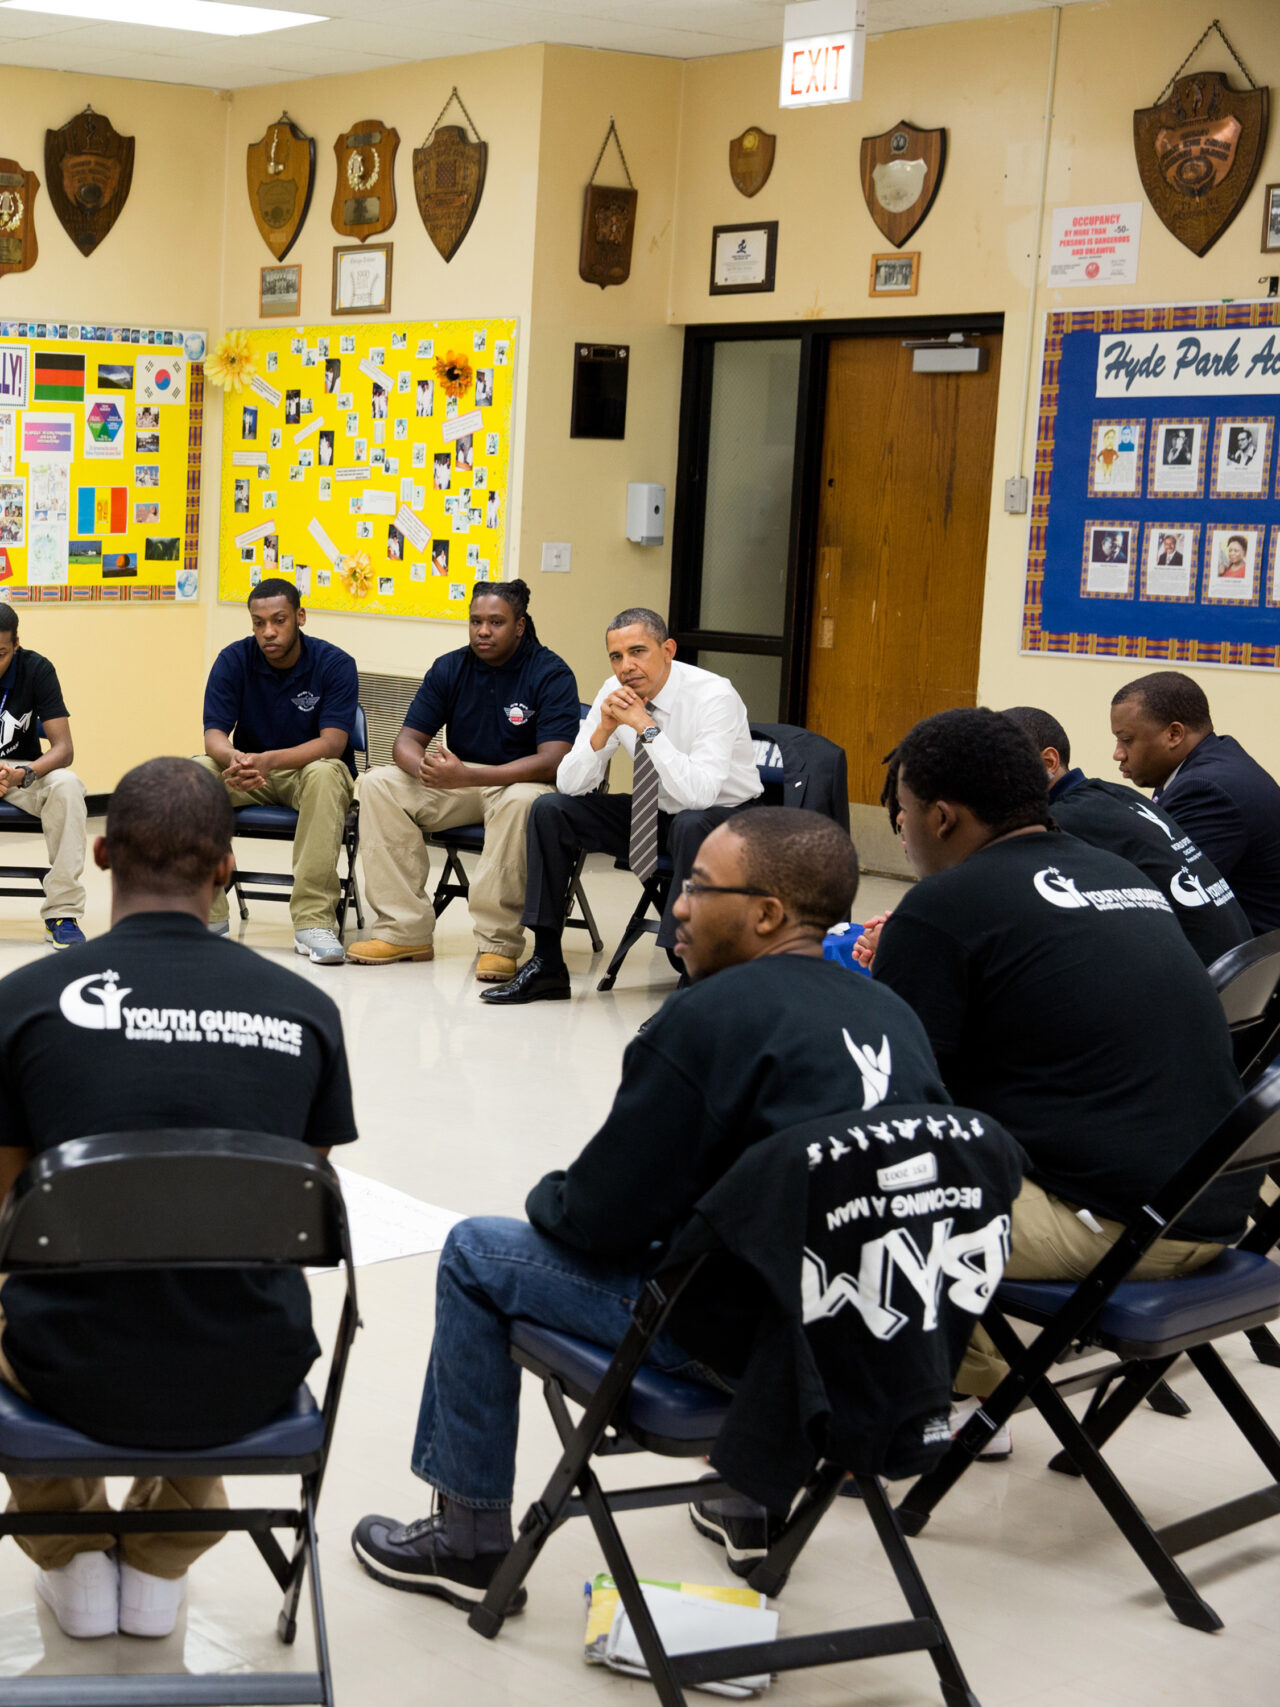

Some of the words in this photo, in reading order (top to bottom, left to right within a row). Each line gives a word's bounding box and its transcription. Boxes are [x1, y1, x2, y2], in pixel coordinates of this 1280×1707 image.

[790, 44, 845, 96] EXIT
[1072, 213, 1122, 227] OCCUPANCY
[1073, 229, 1090, 237] MORE
[1091, 227, 1107, 236] THAN
[1059, 238, 1086, 247] PERSONS
[1094, 235, 1130, 245] DANGEROUS
[1072, 248, 1084, 256] AND
[1085, 246, 1116, 255] UNLAWFUL
[1103, 340, 1166, 392] Hyde
[1173, 337, 1241, 380] Park
[122, 1007, 197, 1032] YOUTH
[199, 1009, 303, 1047] GUIDANCE
[124, 1028, 173, 1044] Guiding
[176, 1028, 203, 1043] kids
[205, 1029, 220, 1044] to
[222, 1030, 260, 1048] bright
[261, 1036, 302, 1058] futures
[825, 1195, 870, 1232] MAN
[869, 1195, 886, 1219] A
[891, 1186, 983, 1218] BECOMING
[800, 1214, 1011, 1342] BAM
